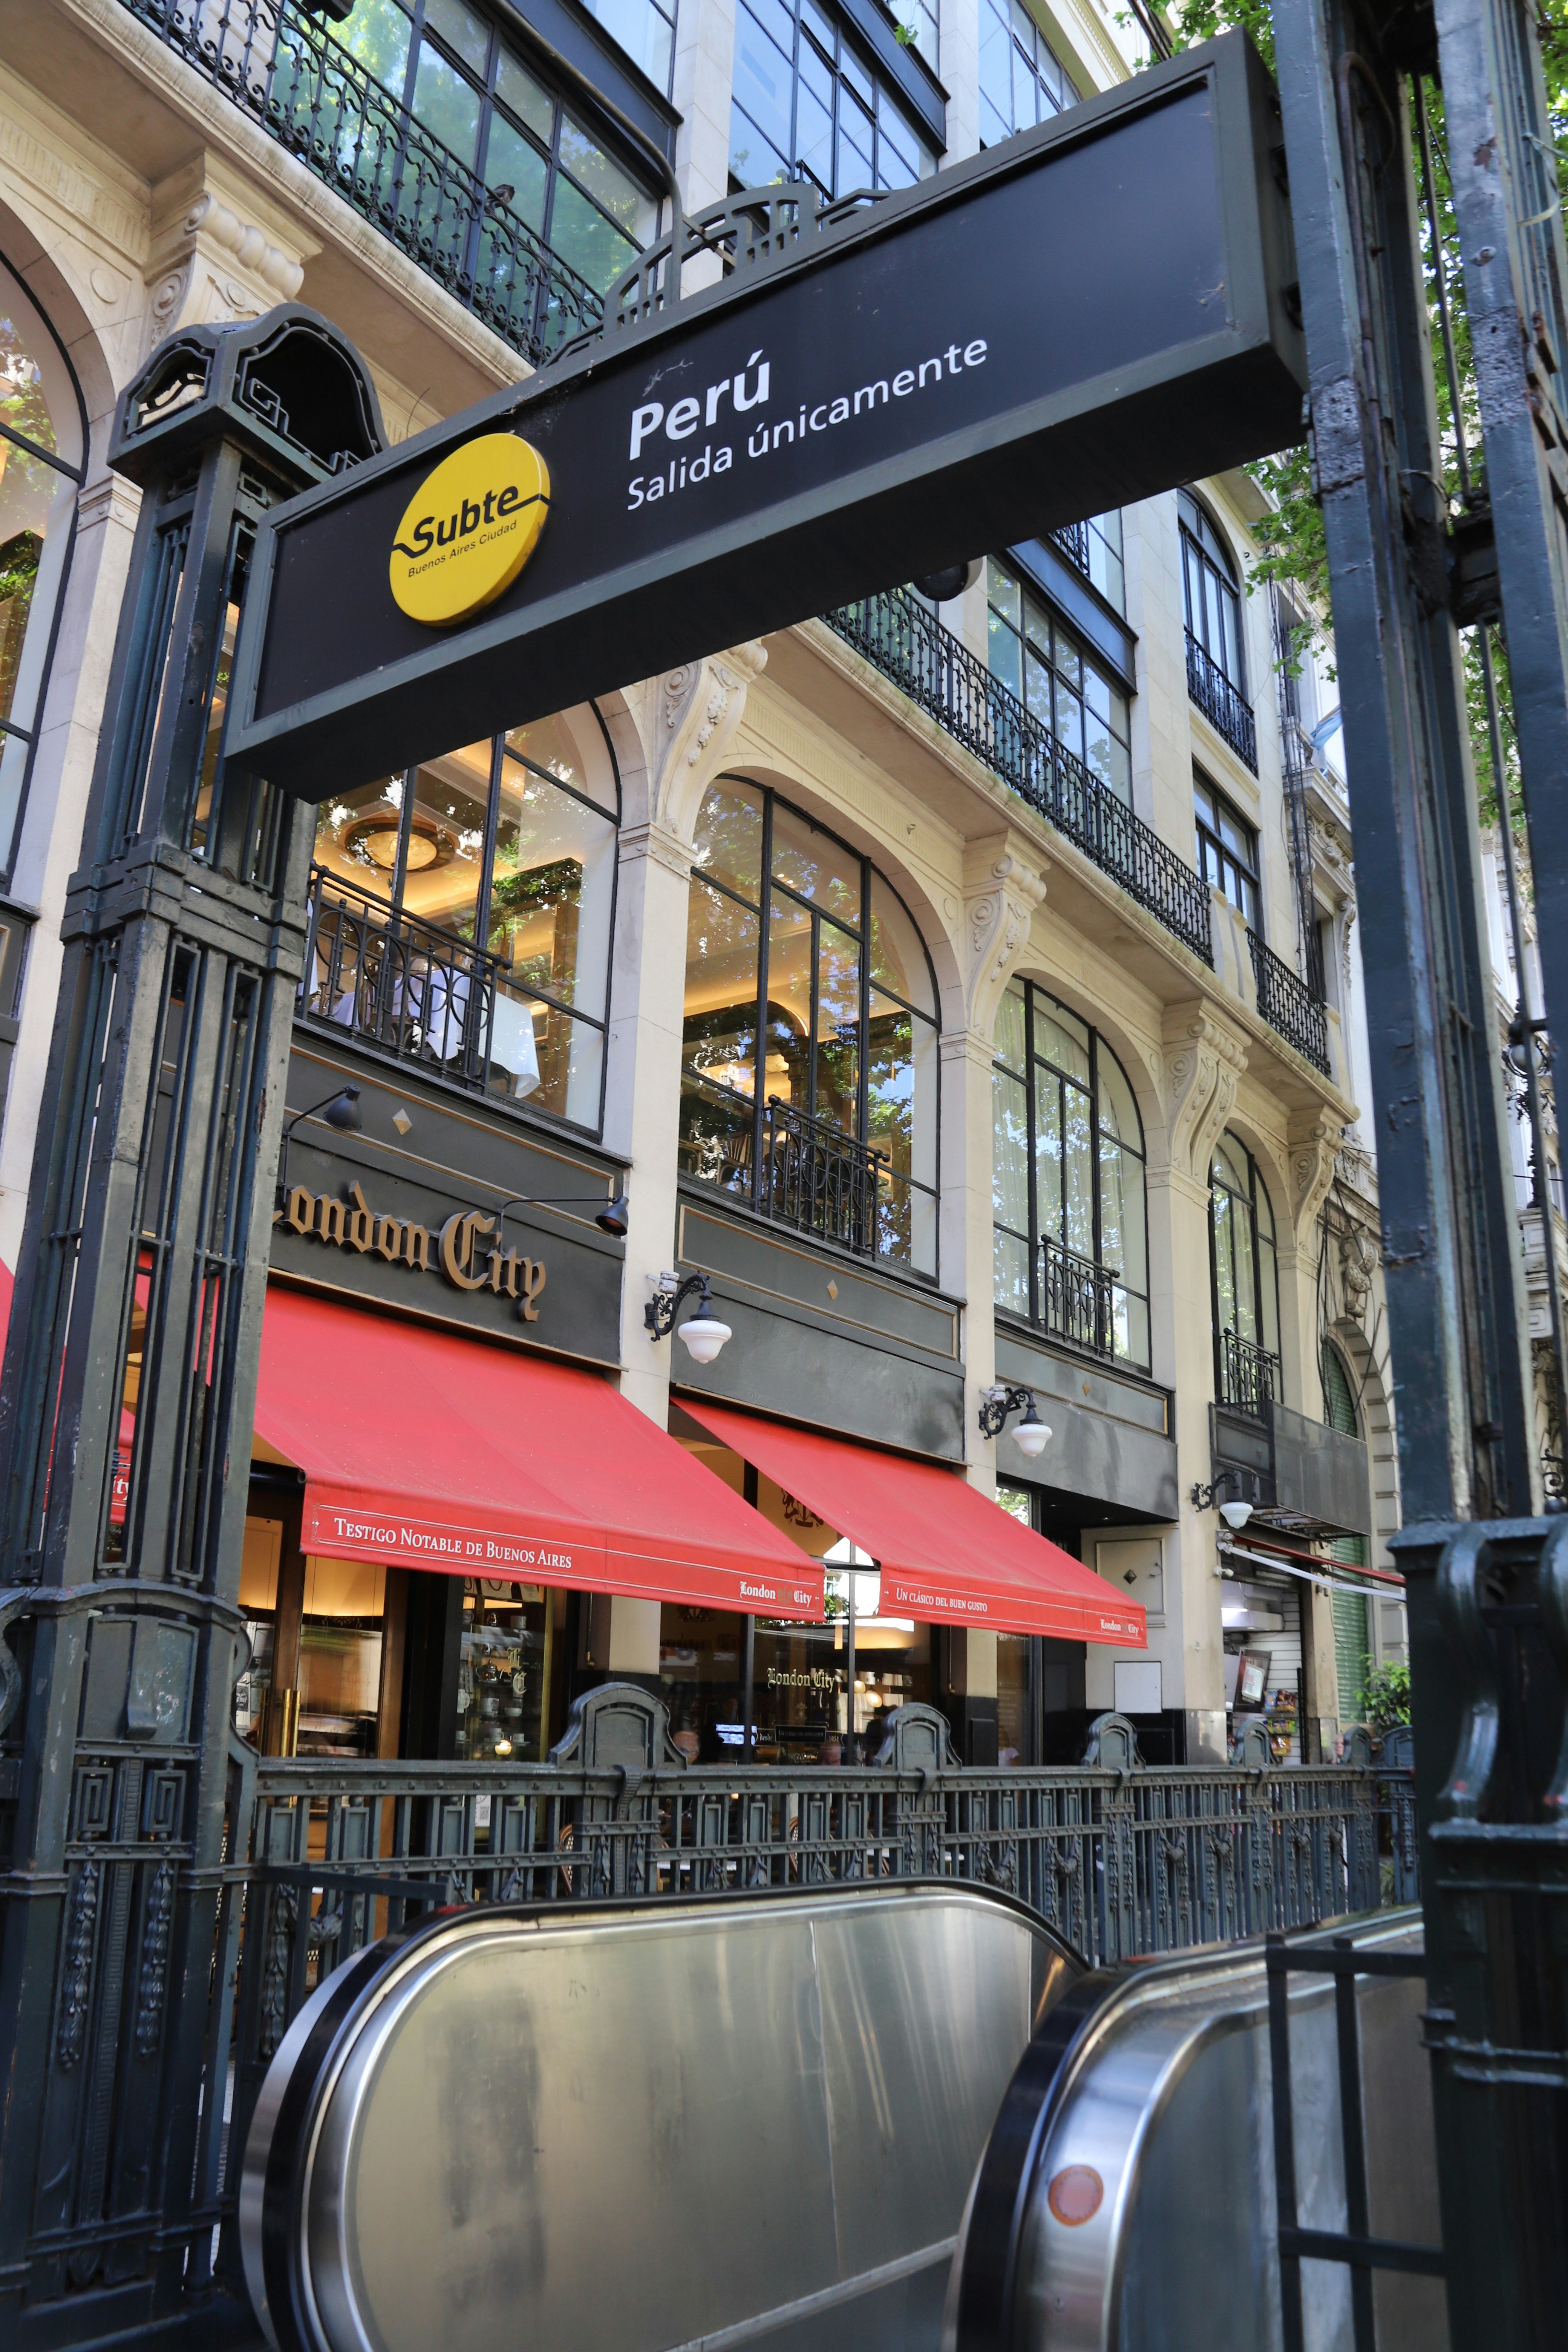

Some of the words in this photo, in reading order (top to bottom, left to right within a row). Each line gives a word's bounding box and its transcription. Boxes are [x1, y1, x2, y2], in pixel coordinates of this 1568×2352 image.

[627, 445, 733, 510] Salida
[748, 338, 988, 458] únicamente
[629, 349, 770, 461] Perú
[405, 486, 524, 559] Subte
[408, 553, 446, 577] Buenos
[450, 542, 475, 559] Aires
[479, 519, 517, 545] Ciudad
[273, 1180, 430, 1272] ondon
[439, 1211, 546, 1322] City
[334, 1517, 397, 1544] TESTIGO
[400, 1528, 462, 1553] NOTABLE
[466, 1541, 483, 1556] DE
[486, 1541, 535, 1563] BUENOS
[537, 1549, 572, 1569] AIRES
[740, 1581, 776, 1600] London
[794, 1590, 812, 1608] City
[896, 1588, 908, 1601] UN
[909, 1590, 934, 1605] CLÁSICO
[935, 1596, 948, 1607] DEL
[949, 1598, 966, 1609] BUEN
[967, 1601, 988, 1612] GUSTO
[1100, 1619, 1121, 1632] London
[1128, 1623, 1139, 1637] City
[767, 1668, 811, 1689] London
[814, 1672, 835, 1693] City
